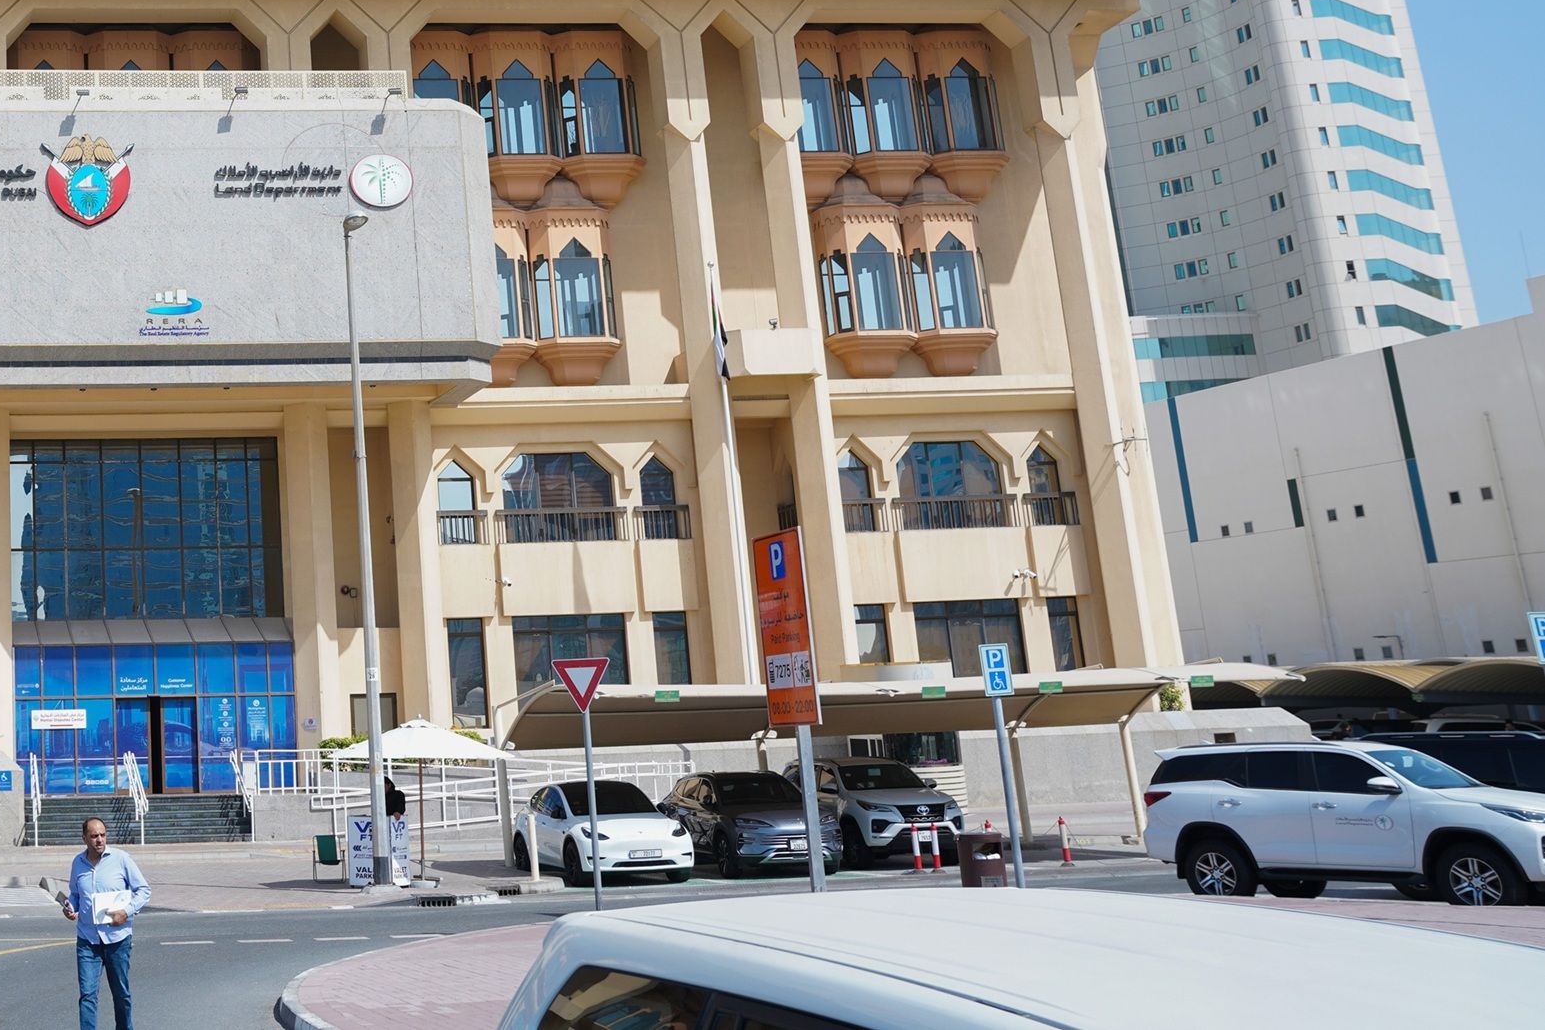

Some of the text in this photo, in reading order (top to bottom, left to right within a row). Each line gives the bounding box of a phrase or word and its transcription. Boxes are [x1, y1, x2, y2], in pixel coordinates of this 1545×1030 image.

[2, 187, 37, 200] DUBAI
[214, 183, 343, 199] Land Department
[770, 543, 783, 579] P
[770, 631, 801, 644] Paid Parking
[988, 649, 1002, 668] P
[775, 664, 791, 678] 7275
[355, 866, 374, 874] VAL
